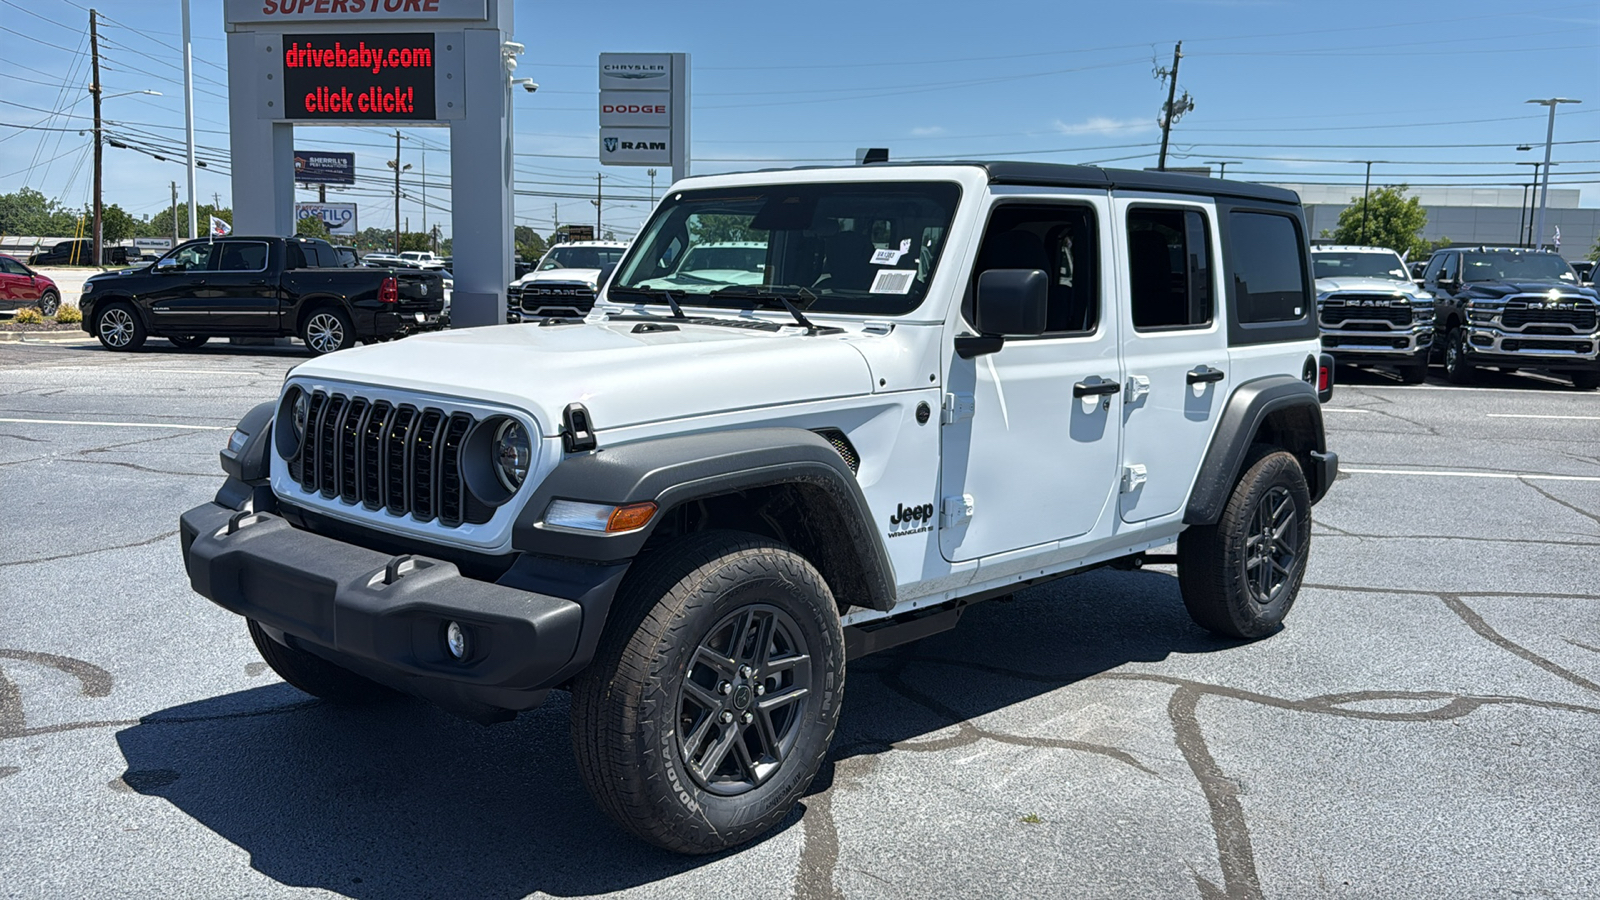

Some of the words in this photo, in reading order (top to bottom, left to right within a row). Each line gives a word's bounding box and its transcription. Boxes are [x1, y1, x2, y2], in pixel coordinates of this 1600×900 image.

[262, 0, 440, 15] SUPERSTORE
[286, 42, 432, 74] drivebaby.com
[305, 86, 354, 113] click
[358, 86, 414, 113] click!
[603, 105, 666, 113] DODGE
[621, 141, 666, 150] RAM
[296, 209, 352, 220] OSTILO
[890, 503, 933, 524] Jeep
[887, 527, 926, 538] WRANGLER
